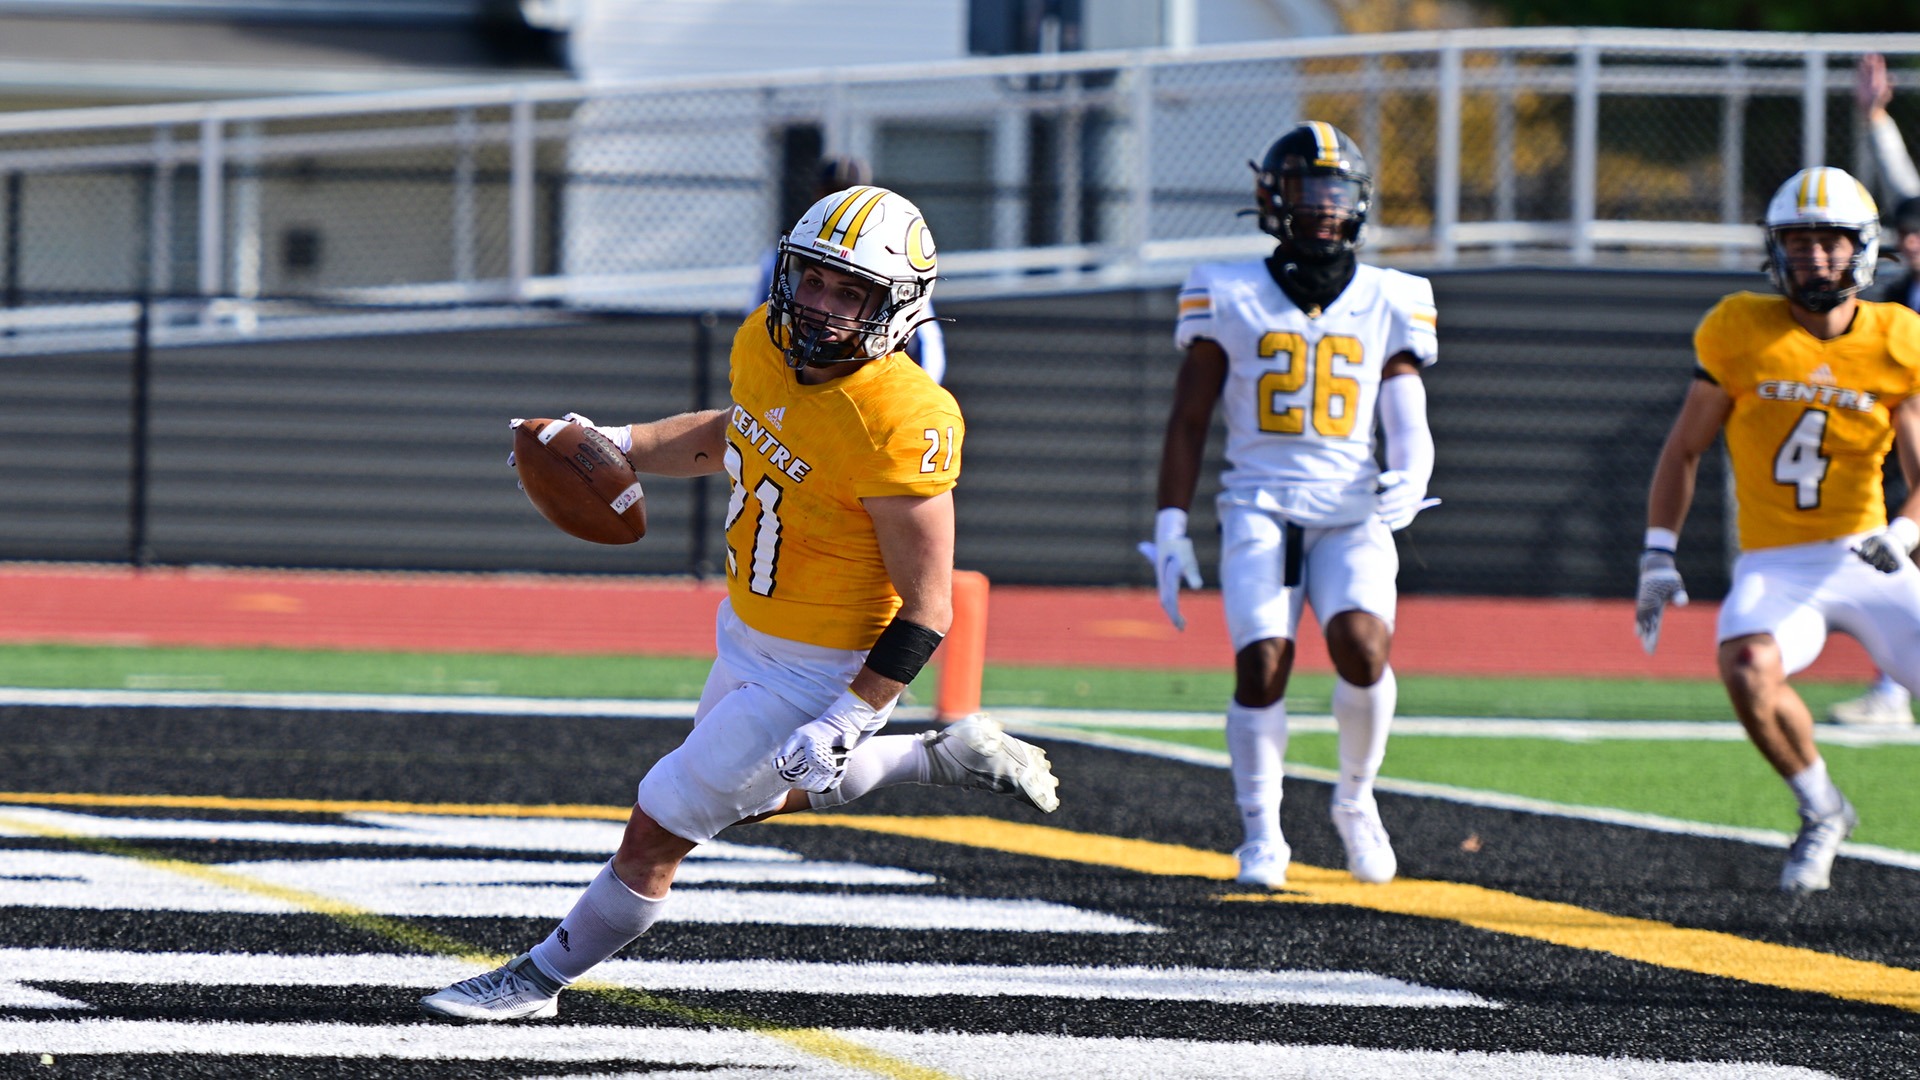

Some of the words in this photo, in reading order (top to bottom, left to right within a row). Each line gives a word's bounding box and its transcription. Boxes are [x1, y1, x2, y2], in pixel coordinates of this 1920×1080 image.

[779, 273, 792, 301] Ridde
[1258, 331, 1363, 437] 26
[1757, 380, 1878, 413] CENTRE
[764, 411, 783, 431] adidas
[576, 453, 594, 472] NCAA
[731, 405, 813, 483] CENTRE
[920, 427, 953, 474] 21
[1774, 407, 1831, 510] 4
